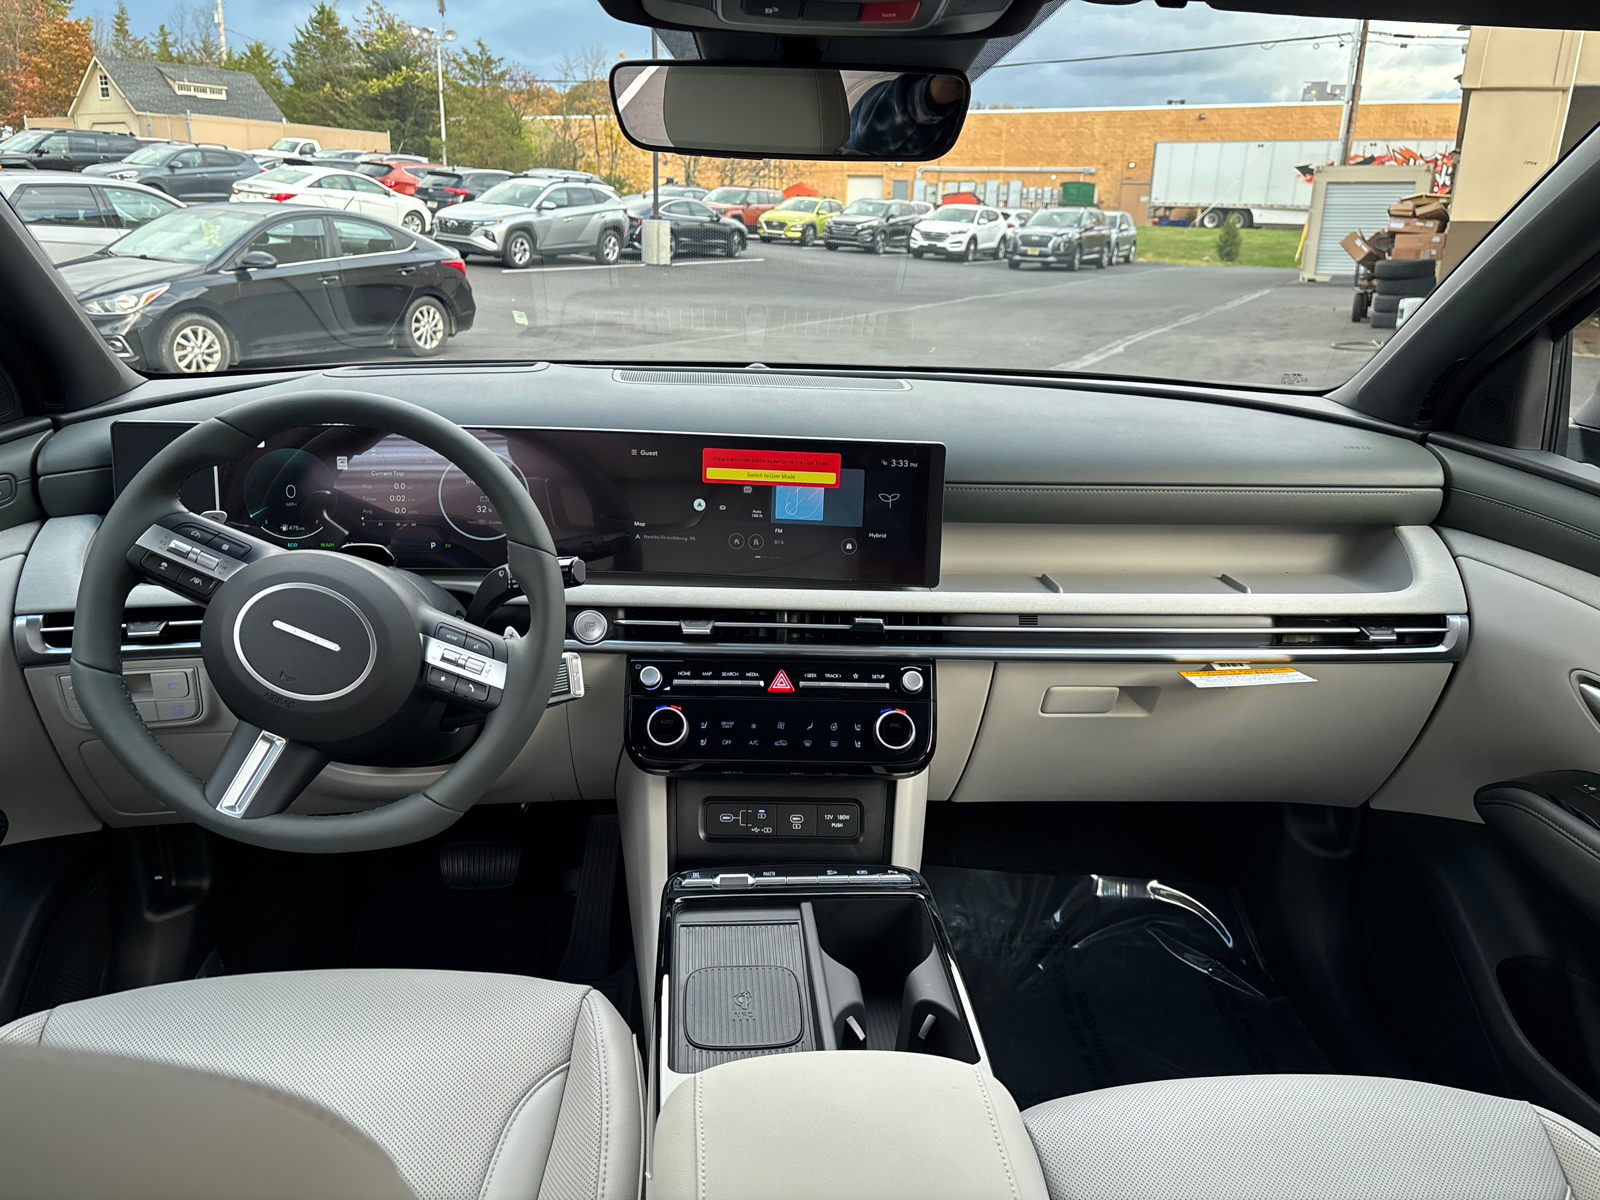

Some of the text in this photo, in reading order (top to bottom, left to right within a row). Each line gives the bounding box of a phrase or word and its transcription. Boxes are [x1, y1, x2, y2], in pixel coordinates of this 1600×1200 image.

[640, 449, 658, 457] Guest
[891, 459, 908, 467] 3:33
[393, 470, 405, 478] Trip
[394, 482, 406, 490] 0.0
[286, 484, 296, 498] 0
[477, 505, 487, 513] 32
[263, 692, 296, 709] AIRBAG
